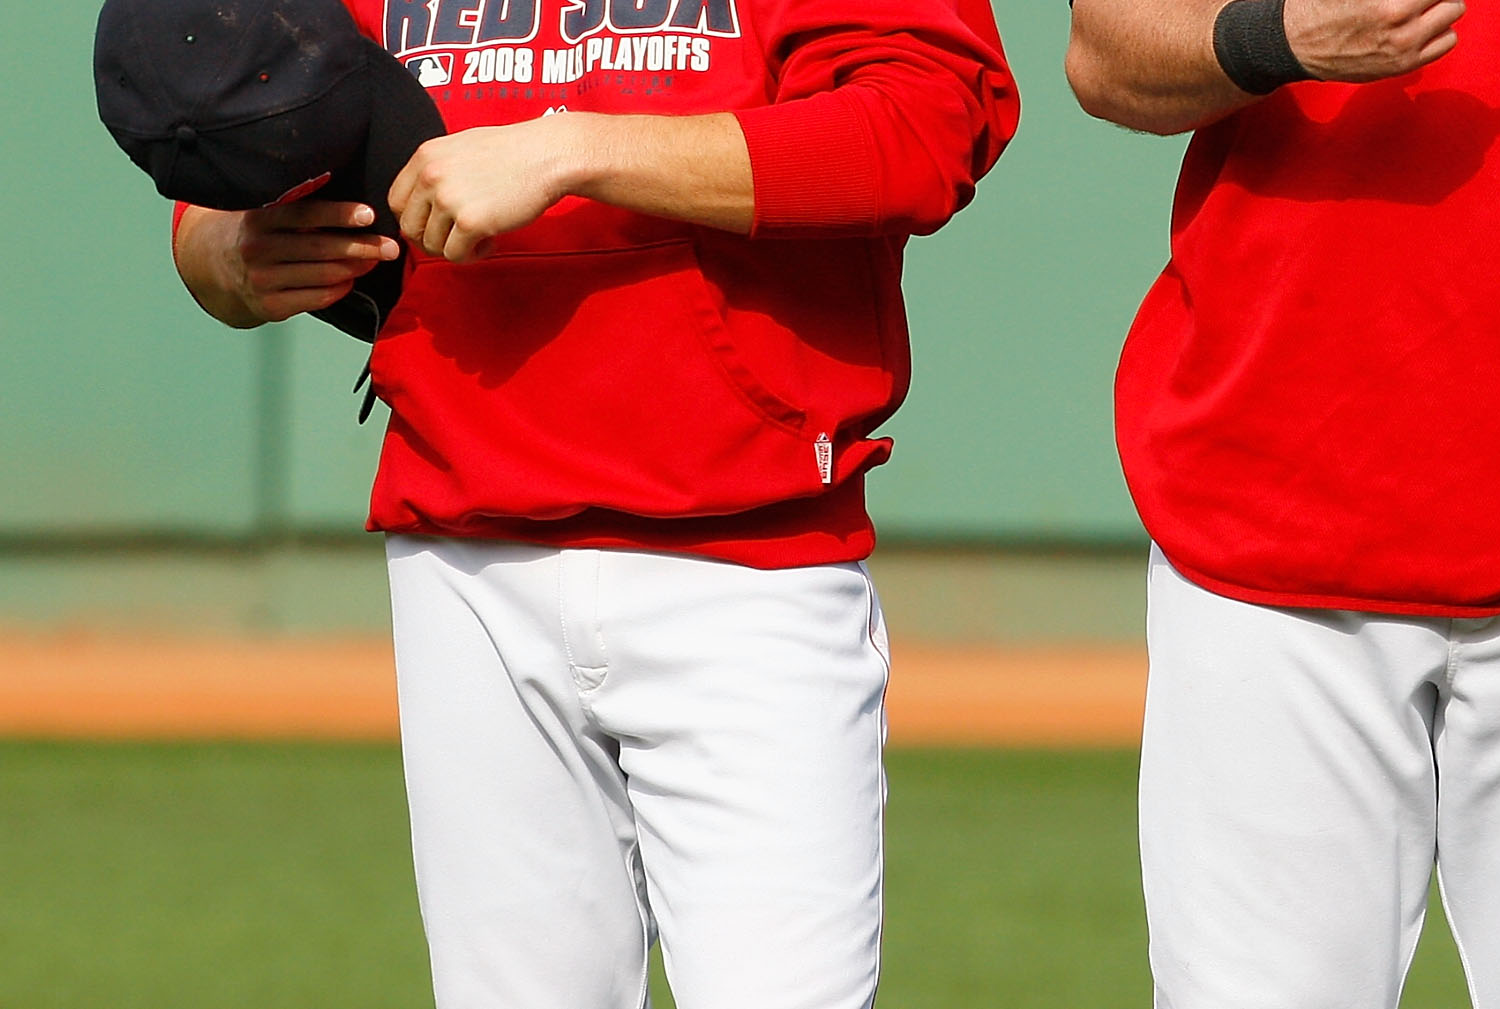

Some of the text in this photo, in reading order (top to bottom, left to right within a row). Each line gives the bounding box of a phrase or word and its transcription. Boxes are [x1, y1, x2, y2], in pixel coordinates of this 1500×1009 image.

[462, 36, 711, 86] 2008 MLB PLAYOFFS
